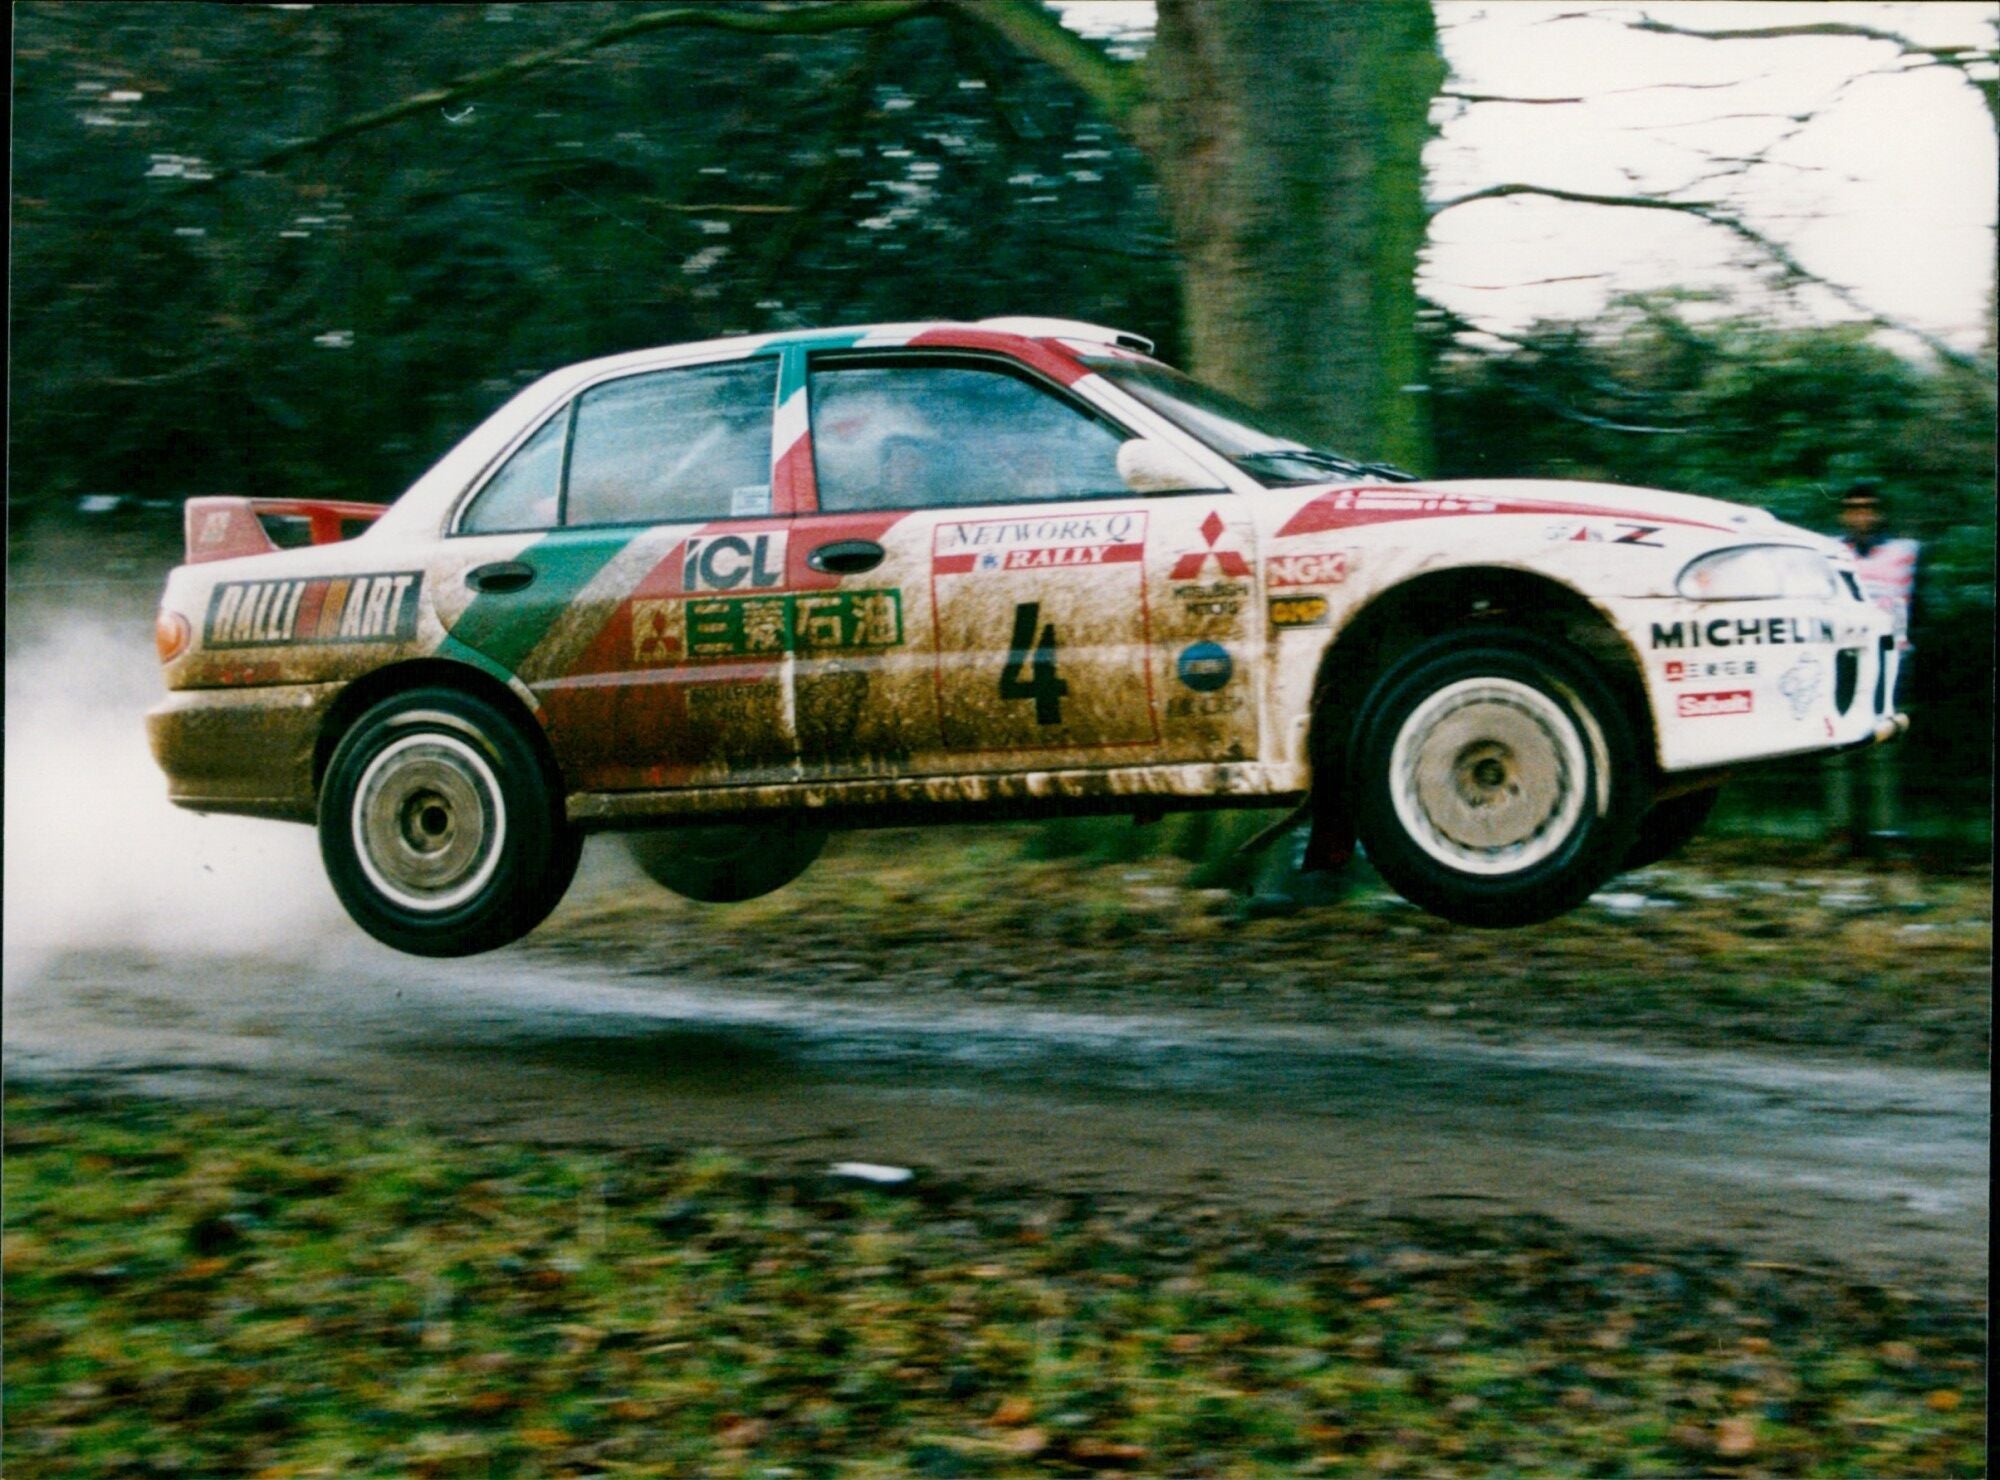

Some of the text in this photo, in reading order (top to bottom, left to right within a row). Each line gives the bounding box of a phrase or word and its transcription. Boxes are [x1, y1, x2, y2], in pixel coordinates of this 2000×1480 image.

[951, 515, 1131, 547] NETWORK Q
[1008, 545, 1111, 569] RALLY
[1268, 554, 1347, 587] NGK
[693, 592, 899, 652] 三菱石油
[1000, 602, 1068, 725] 4
